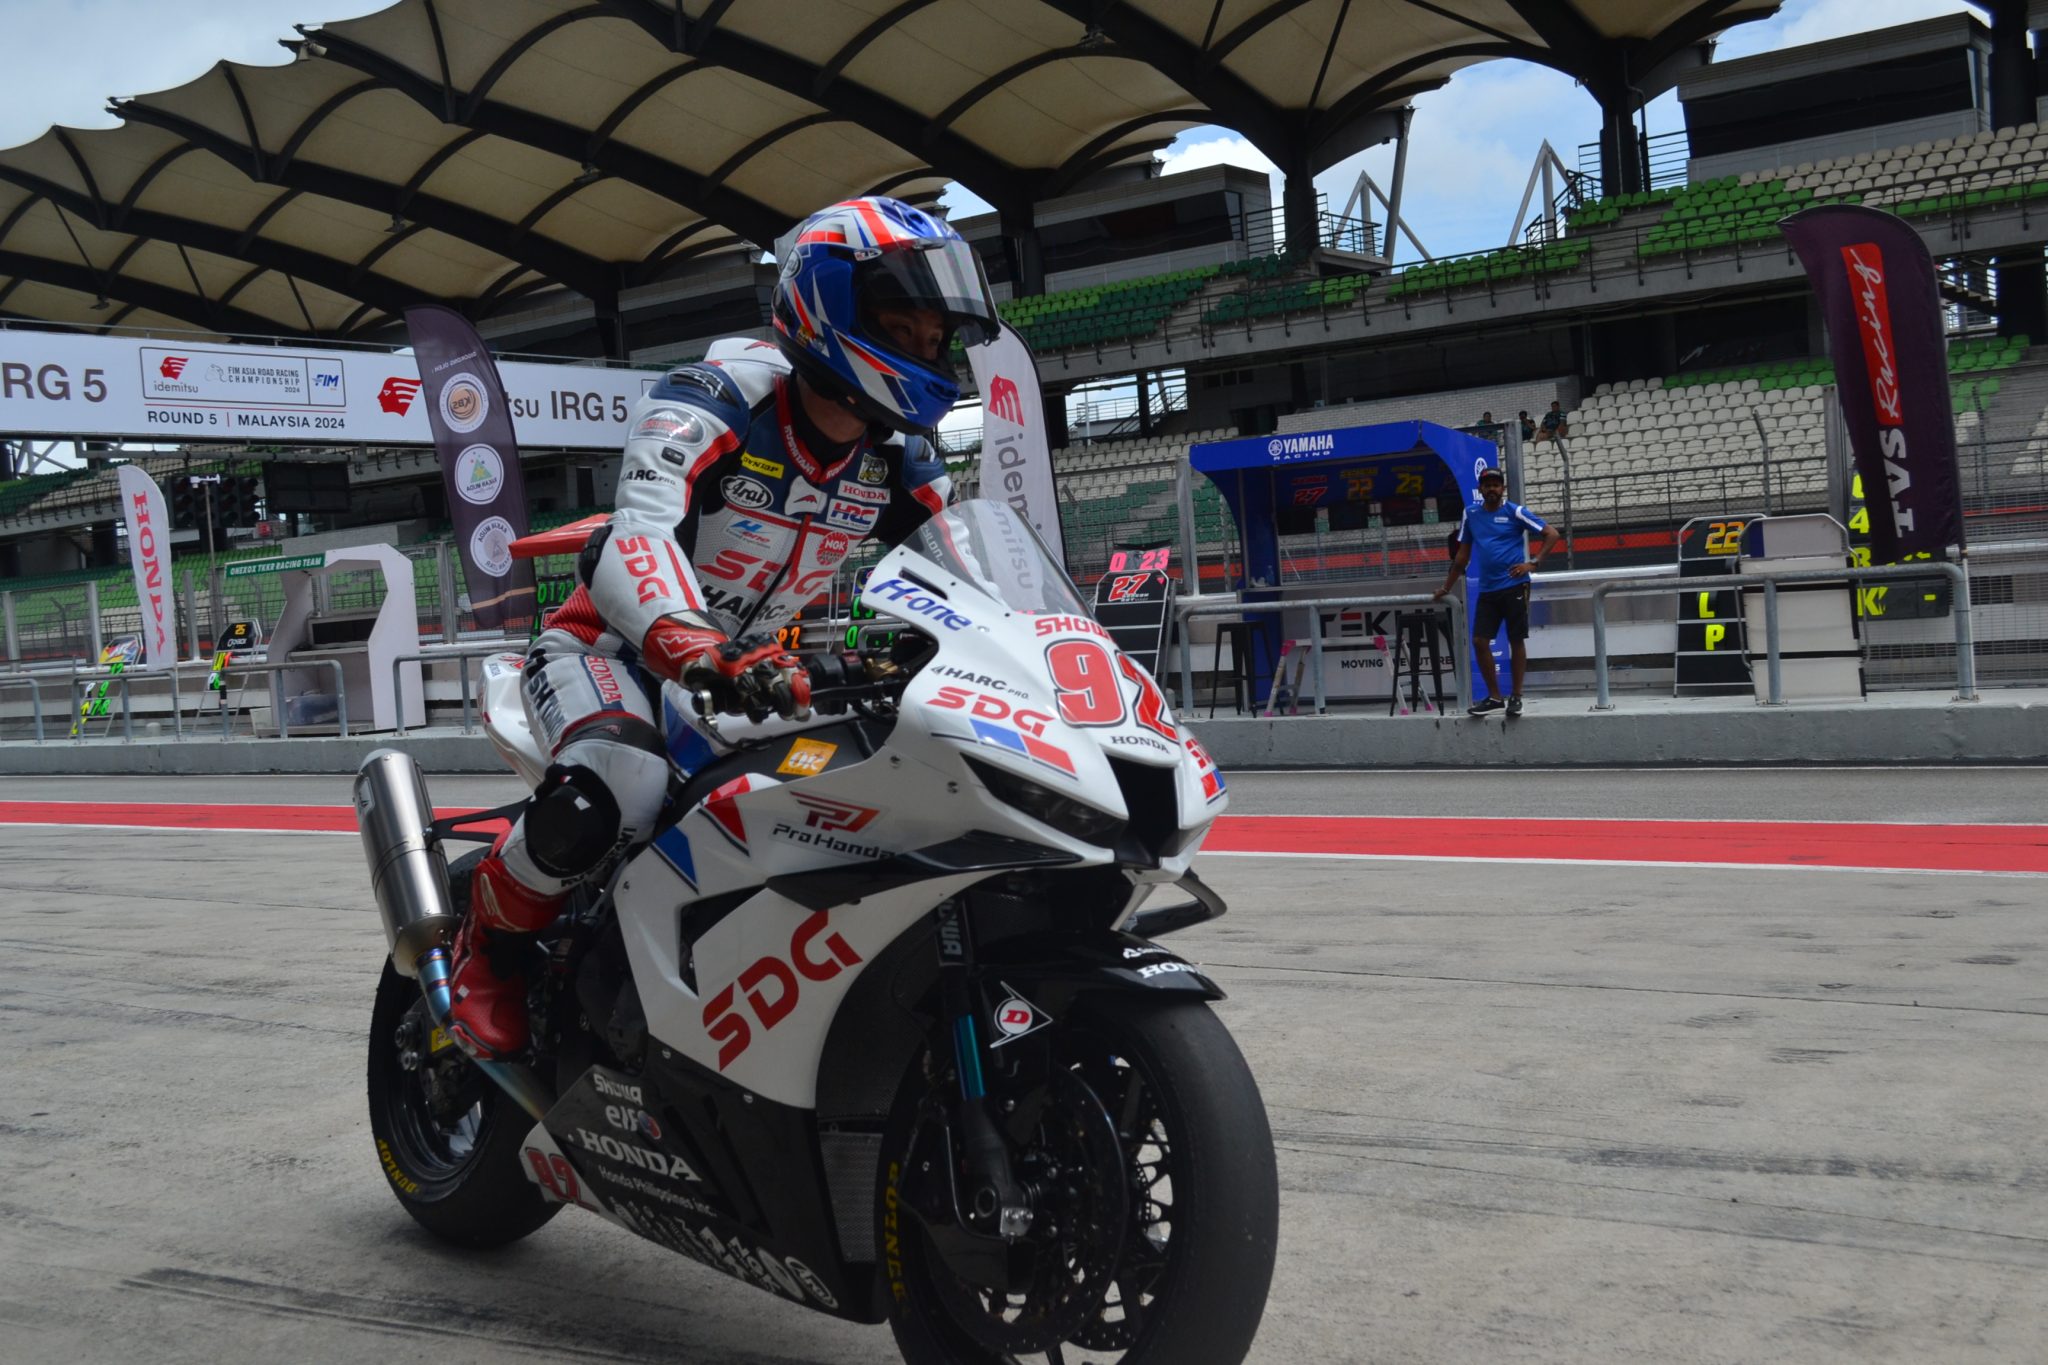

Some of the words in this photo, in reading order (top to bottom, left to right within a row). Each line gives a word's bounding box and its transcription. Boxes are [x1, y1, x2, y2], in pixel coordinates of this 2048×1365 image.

[1848, 248, 1901, 420] Racing
[83, 368, 108, 403] 5
[228, 366, 241, 375] FIM
[242, 367, 257, 376] ASIA
[258, 368, 275, 377] ROAD
[276, 369, 300, 378] RACING
[228, 374, 300, 386] CHAMPIONSHIP
[312, 374, 340, 387] FIM
[153, 381, 199, 394] idemitsu
[147, 410, 204, 426] ROUND
[209, 413, 218, 426] 5
[238, 414, 311, 428] MALAYSIA
[315, 417, 345, 429] 2024
[551, 390, 605, 422] IRG
[611, 395, 628, 423] 5
[1273, 450, 1331, 461] RACING
[1283, 434, 1335, 453] YAMAHA
[743, 455, 779, 473] DUNLOP
[727, 479, 766, 504] Arai
[842, 484, 888, 501] HONDA
[1879, 427, 1915, 539] TVS
[830, 502, 877, 526] HRC
[824, 539, 846, 550] NGK
[1705, 521, 1745, 550] 22
[275, 560, 302, 570] RACING
[302, 557, 322, 567] TEAM
[615, 535, 672, 607] SDG
[1140, 548, 1170, 570] 23
[133, 490, 166, 656] HONDA
[697, 550, 837, 596] SDG
[1108, 573, 1151, 602] 27
[870, 579, 973, 632] H-one
[1699, 591, 1715, 619] L
[1705, 624, 1725, 652] P
[1341, 657, 1384, 669] MOVING
[584, 655, 623, 704] HONDA
[1044, 638, 1181, 746] 92
[926, 686, 1057, 739] SDG
[1110, 735, 1171, 755] HONDA
[702, 908, 864, 1073] SDG
[1001, 1009, 1030, 1025] D
[604, 1105, 639, 1132] elf
[576, 1127, 703, 1182] HONDA
